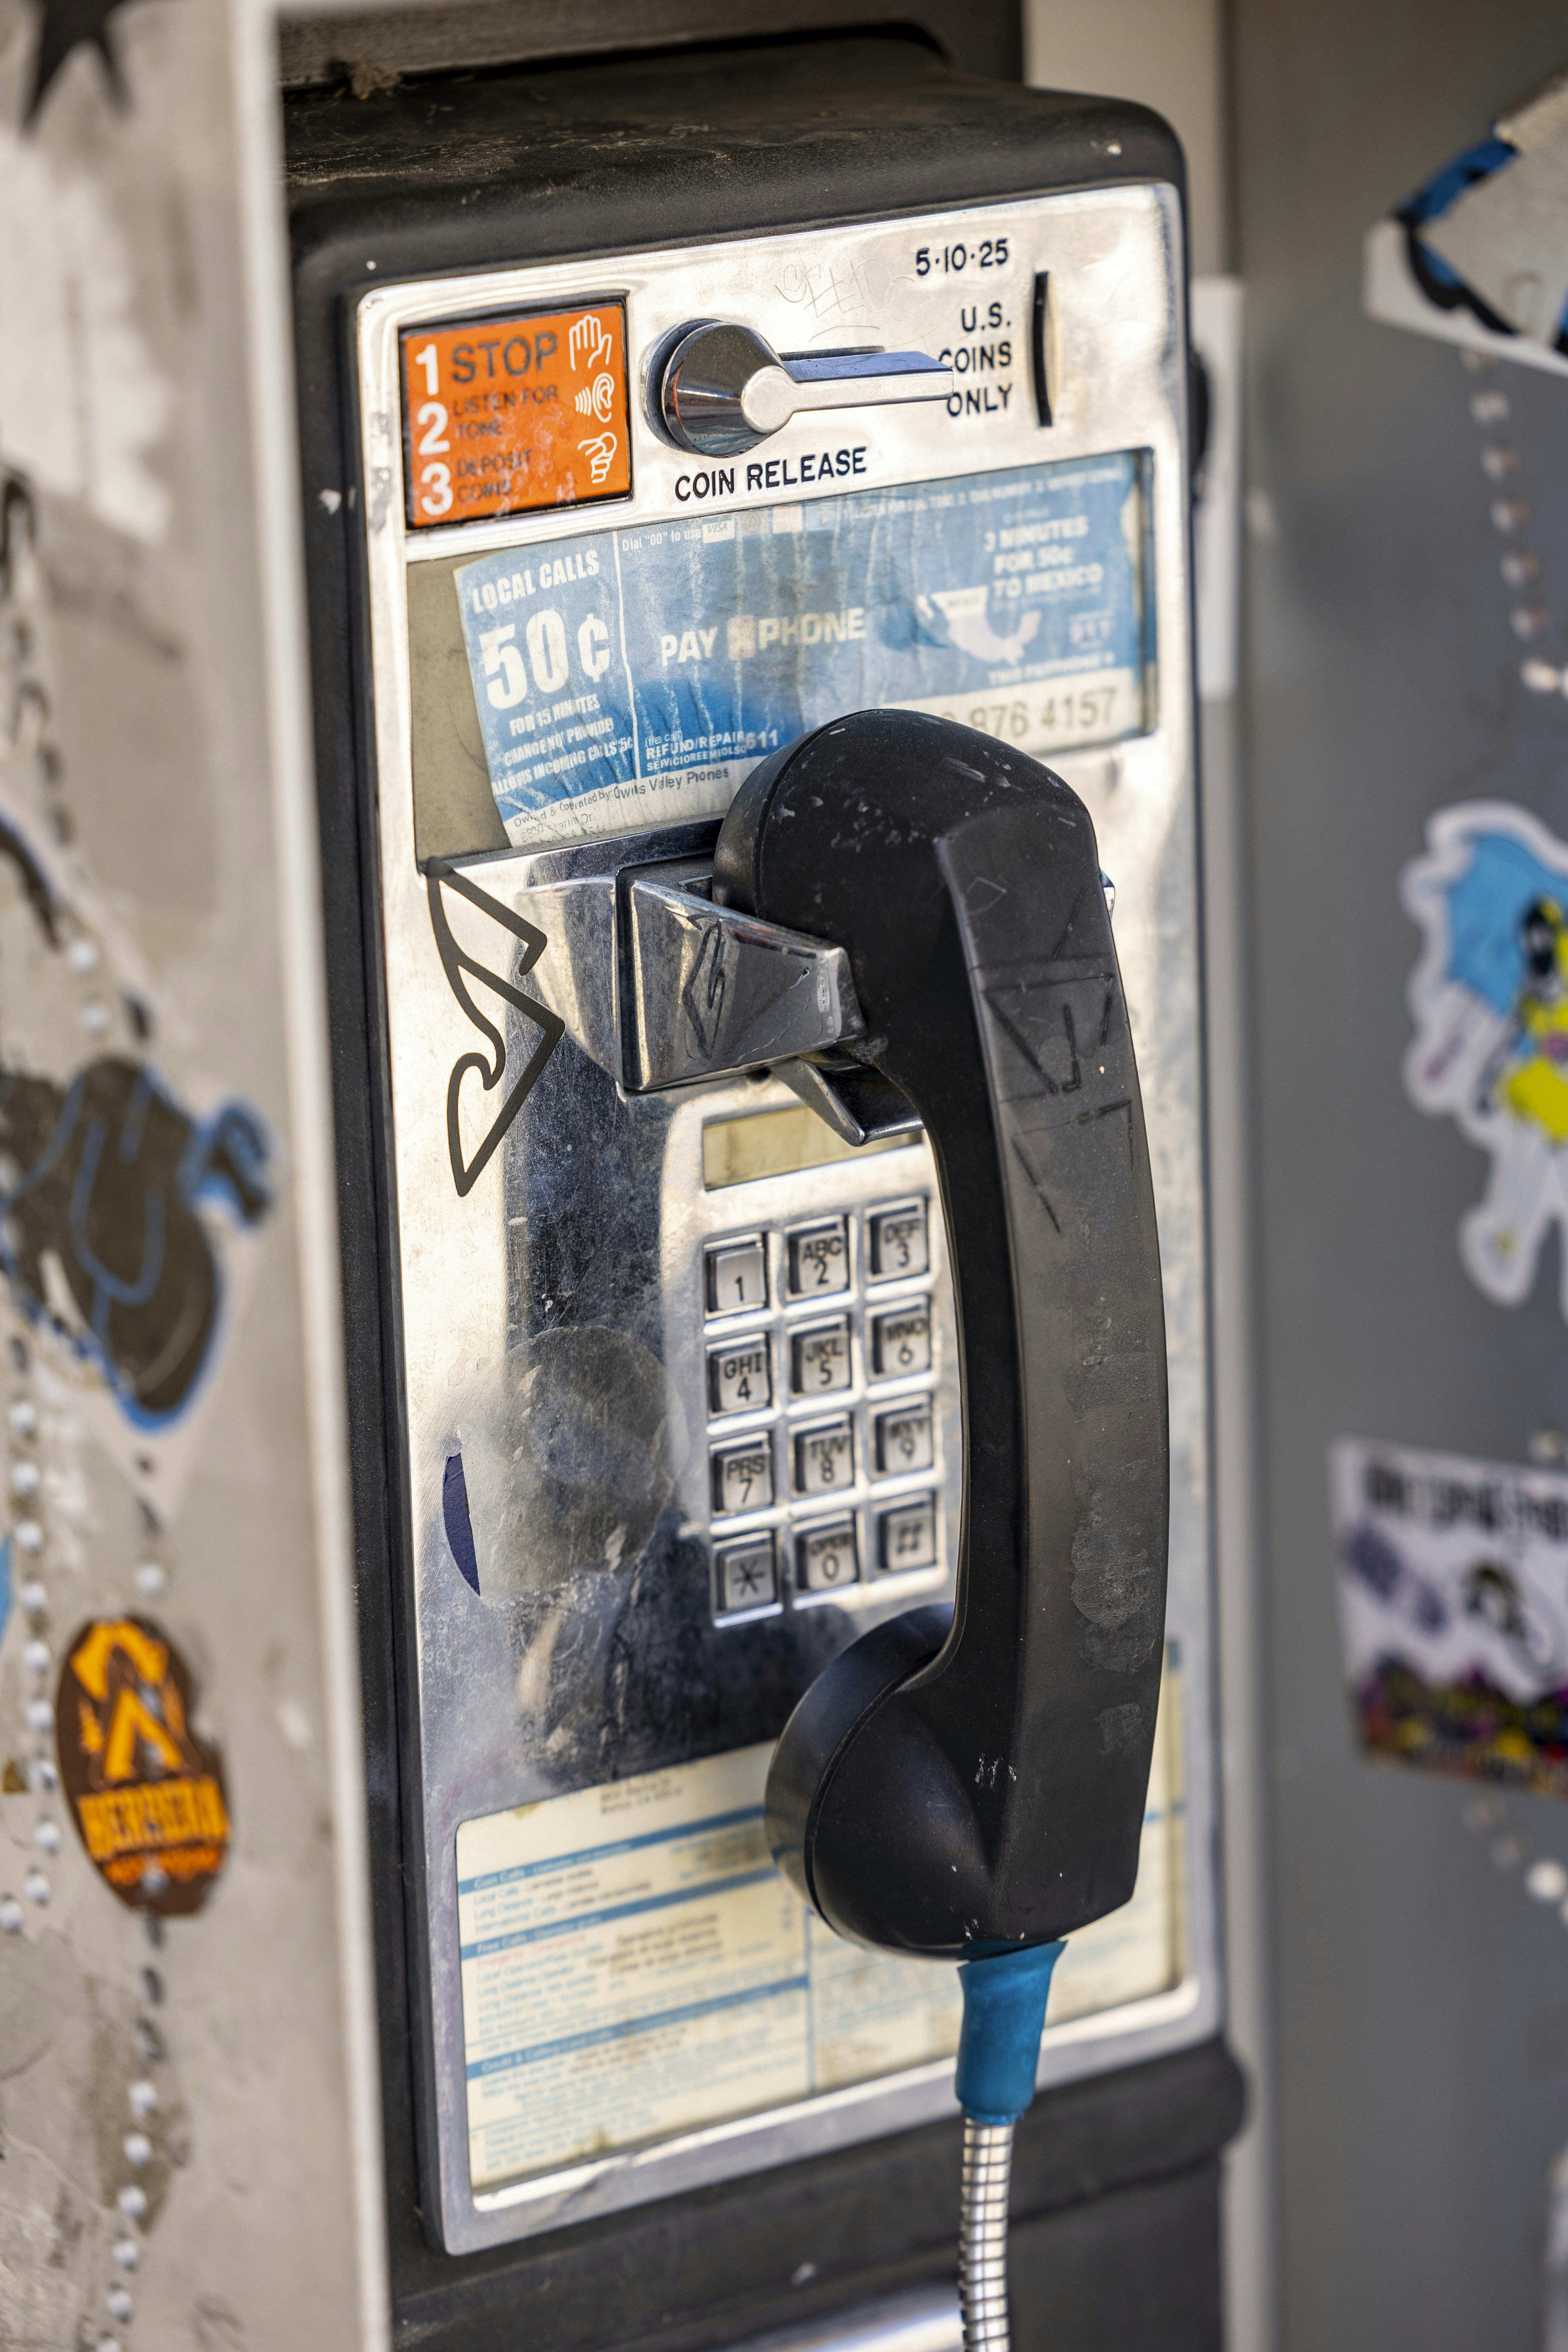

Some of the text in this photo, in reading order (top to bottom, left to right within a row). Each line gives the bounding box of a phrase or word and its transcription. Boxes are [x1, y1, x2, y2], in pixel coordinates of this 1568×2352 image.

[962, 302, 1011, 331] U.S.
[416, 343, 439, 395] 1
[451, 332, 557, 384] STOP
[938, 341, 1012, 372] COINS
[454, 385, 558, 416] LISTEN FOR
[947, 383, 1012, 416] ONLY
[417, 402, 450, 455] 2
[456, 420, 502, 439] TONE
[457, 451, 530, 477] DEPOSIT
[675, 446, 867, 501] COIN RELEASE
[421, 462, 453, 515] 3
[457, 482, 512, 504] COINS
[622, 536, 642, 552] Dial
[671, 531, 680, 542] to
[684, 528, 701, 540] use
[707, 522, 727, 534] VISA
[1001, 515, 1089, 550] MINUTES
[994, 550, 1034, 576] FOR
[472, 550, 600, 614] LOCAL CALLS
[992, 562, 1103, 598] TO MEXICO
[661, 607, 866, 667] PAY PHONE
[509, 715, 536, 737] FOR
[536, 708, 552, 727] 15
[969, 687, 1117, 738] 876 4157
[746, 729, 778, 750] 611
[504, 739, 546, 767] CHANGE
[550, 807, 556, 817] &
[581, 813, 596, 825] Dr.
[803, 1237, 842, 1264] ABC
[897, 1243, 910, 1268] 3
[814, 1259, 829, 1285] 2
[735, 1276, 744, 1302] 1
[724, 1352, 762, 1380] GHI
[898, 1342, 914, 1365] 6
[819, 1359, 832, 1385] 5
[737, 1376, 751, 1400] 4
[727, 1455, 766, 1479] PRS
[821, 1456, 835, 1482] 8
[739, 1478, 752, 1504] 7
[823, 1554, 839, 1580] 0
